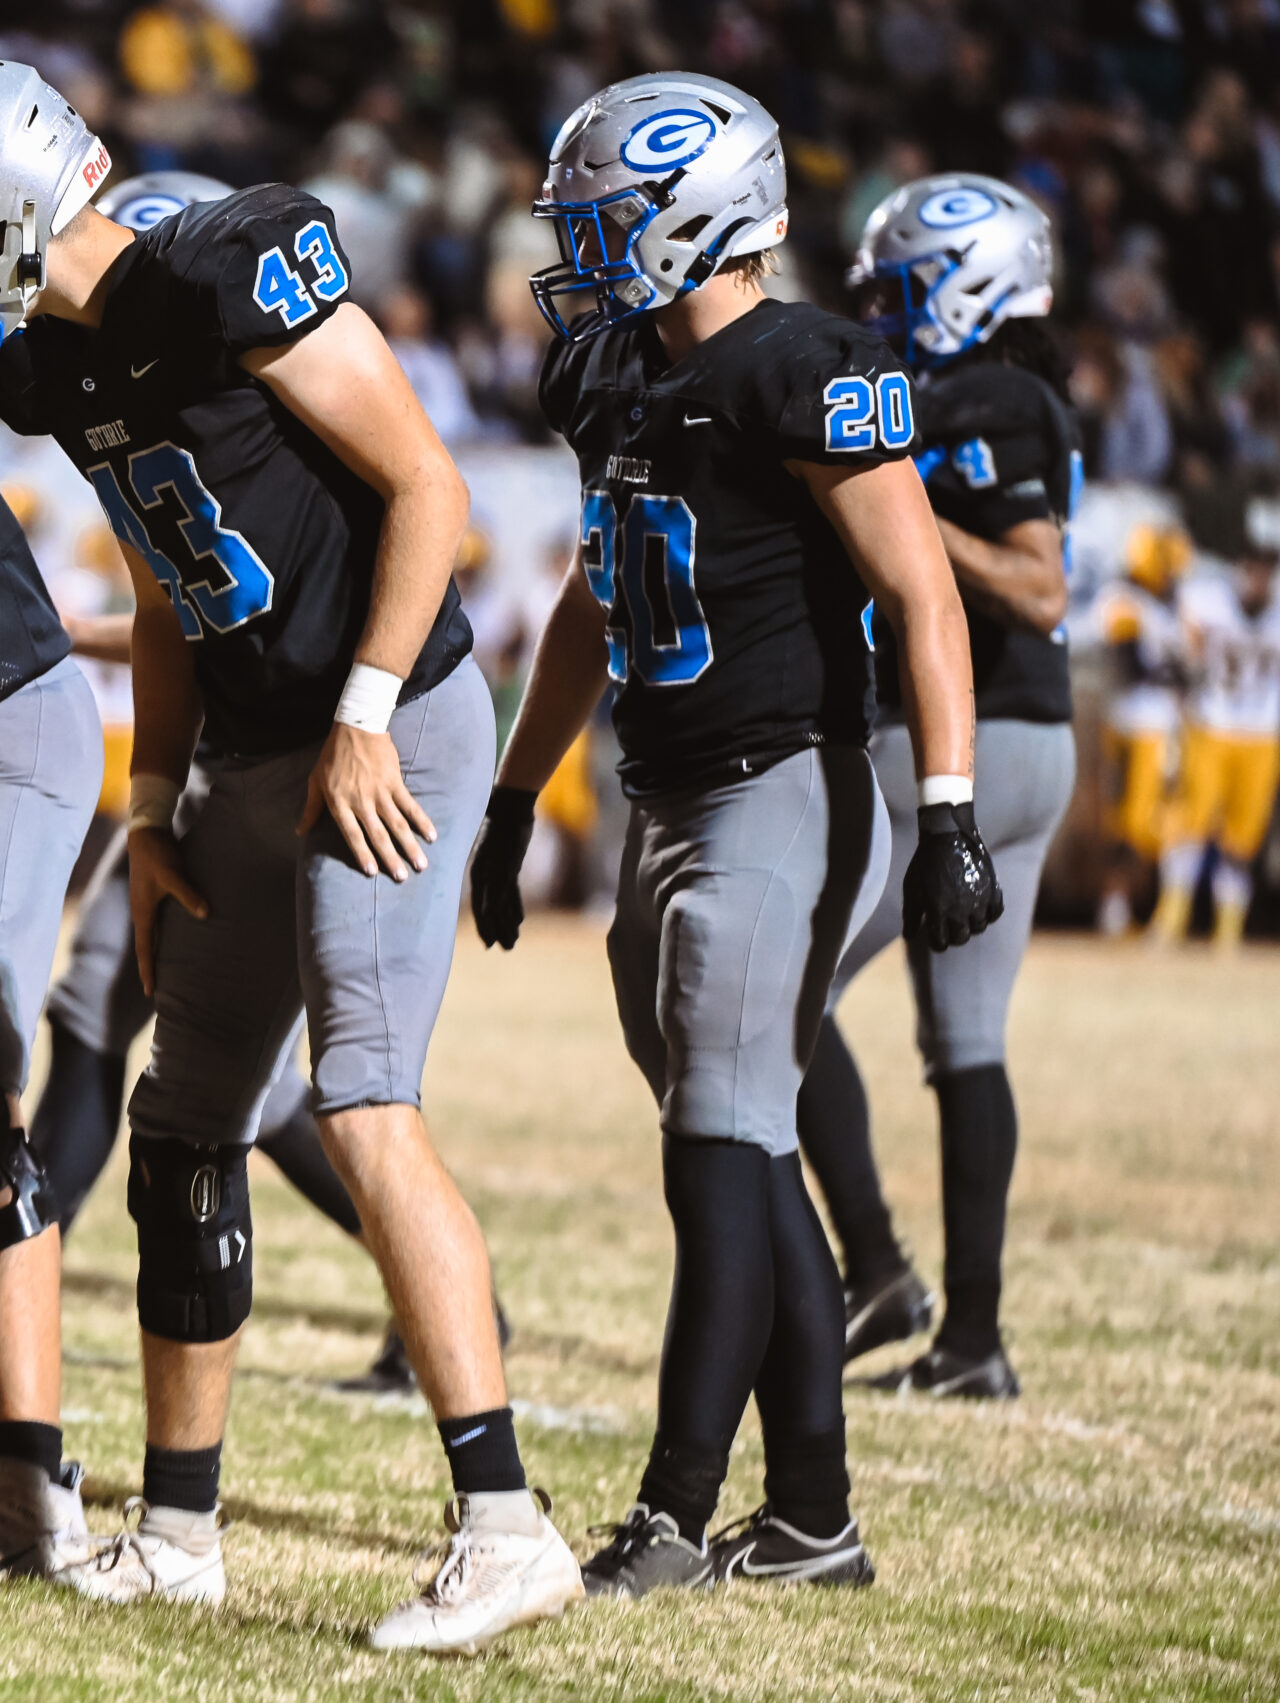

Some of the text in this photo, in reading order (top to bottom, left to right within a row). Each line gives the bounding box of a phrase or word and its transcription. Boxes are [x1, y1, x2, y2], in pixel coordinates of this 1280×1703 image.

[83, 146, 108, 188] Rid
[620, 108, 716, 174] G
[253, 220, 348, 330] 43
[82, 378, 96, 392] G
[823, 371, 914, 452] 20
[85, 419, 131, 451] GUTHRIE
